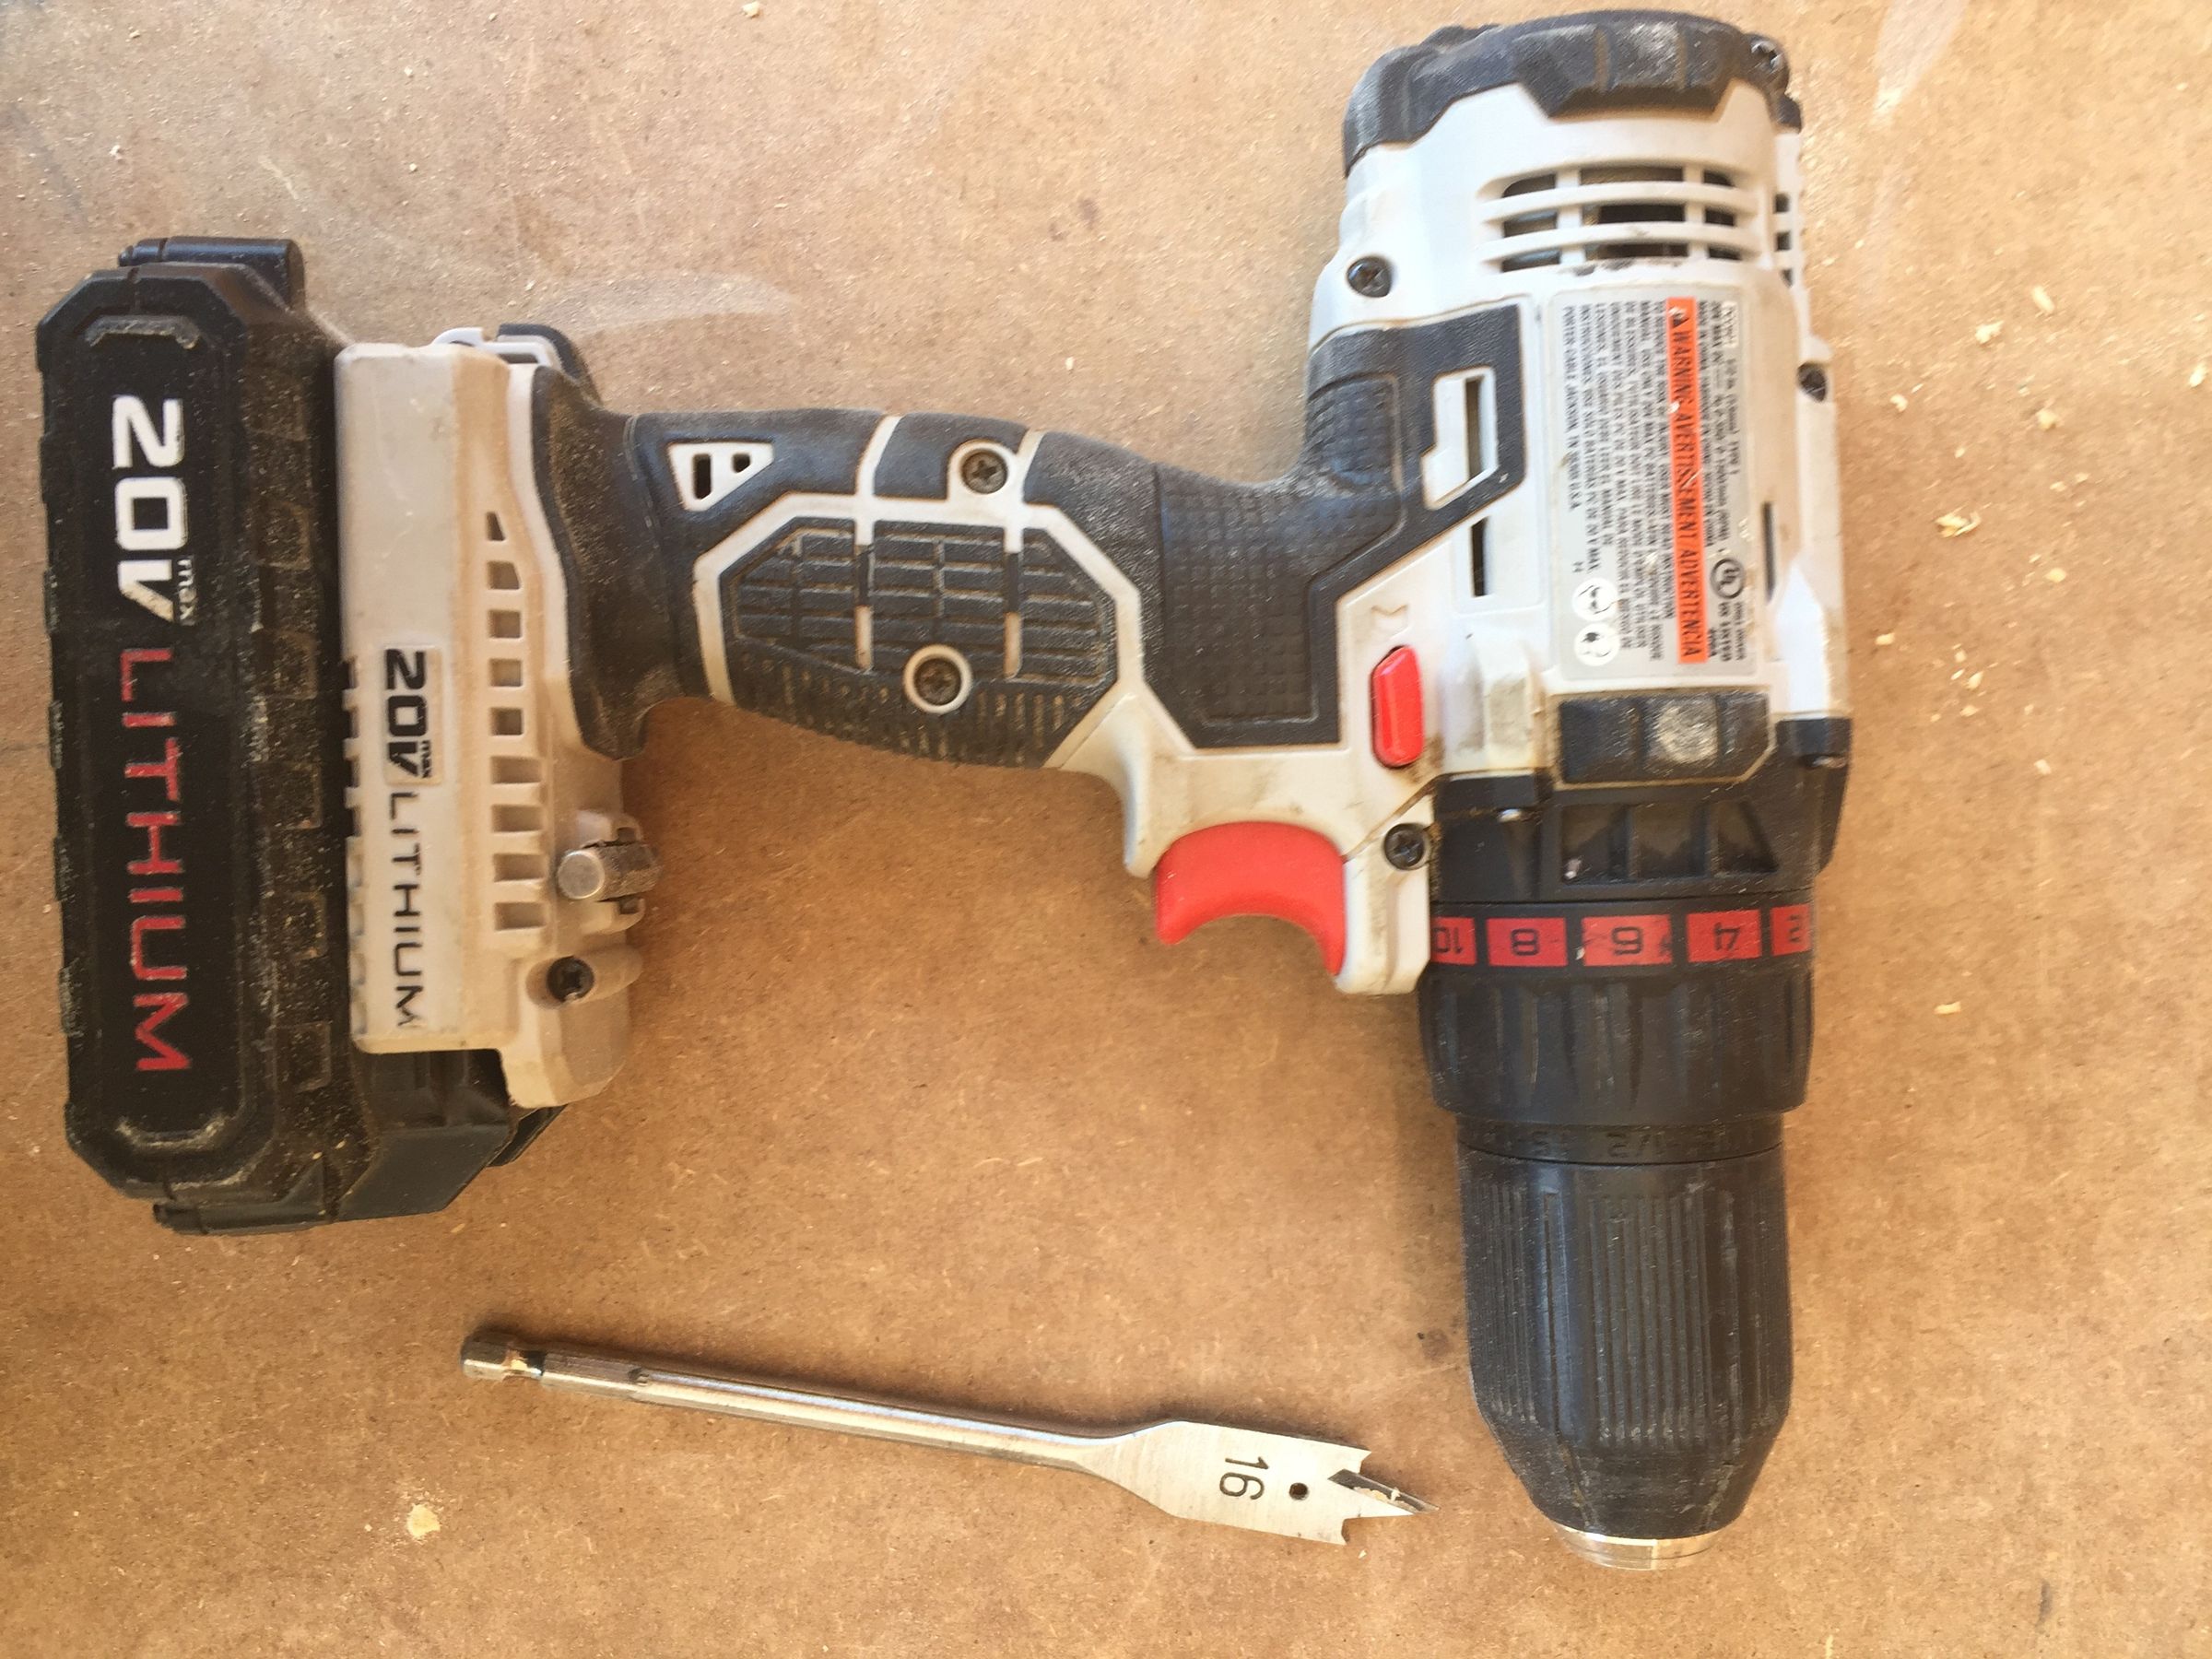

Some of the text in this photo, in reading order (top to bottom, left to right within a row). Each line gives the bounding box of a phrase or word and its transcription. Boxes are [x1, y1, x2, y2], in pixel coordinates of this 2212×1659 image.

[112, 395, 188, 623] 20V
[1672, 331, 1702, 656] WARNING AVERTISSEMENT ADVERTENCIA
[385, 648, 428, 777] 20V
[121, 648, 191, 1072] LITHIUM
[390, 791, 424, 1027] LITHIUM
[1433, 926, 1464, 955] 10
[1510, 927, 1540, 957] 8
[1610, 925, 1644, 956] 6
[1713, 922, 1741, 951] 4
[1218, 1455, 1269, 1500] 16
